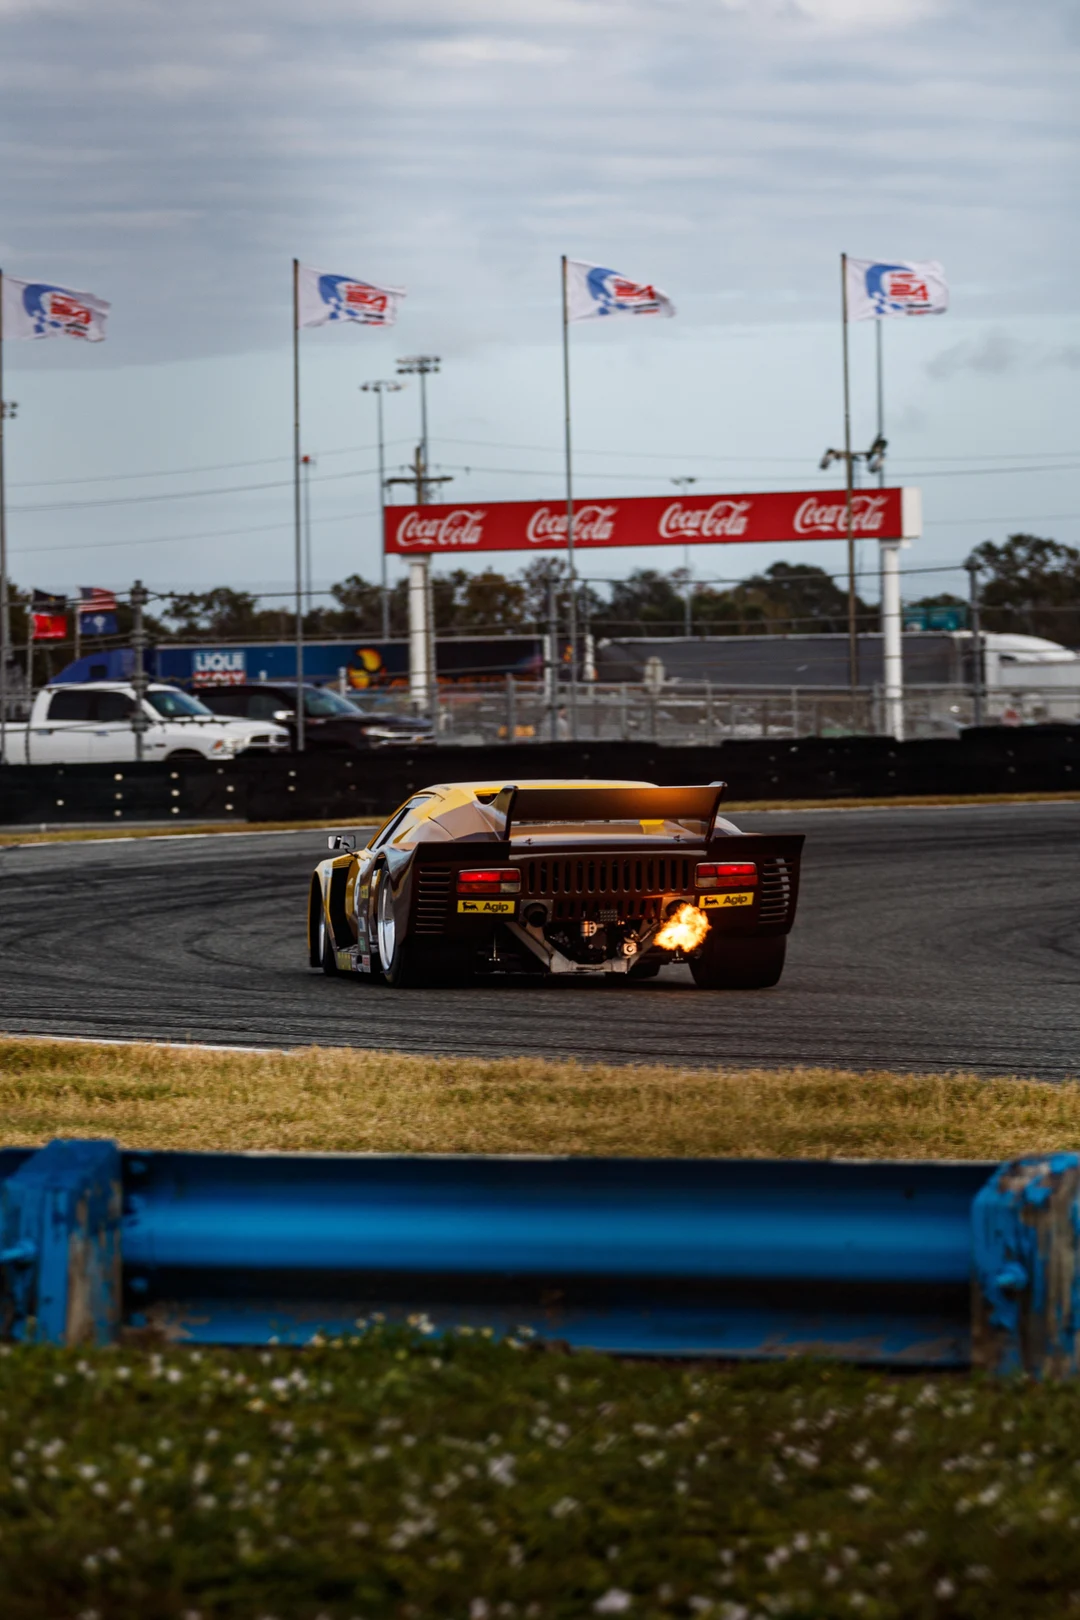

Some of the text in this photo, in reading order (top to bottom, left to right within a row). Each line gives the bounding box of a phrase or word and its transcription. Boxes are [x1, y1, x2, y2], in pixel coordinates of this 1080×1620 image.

[396, 509, 488, 547] Coca-Cola
[658, 499, 754, 539] Coca-Cola
[194, 651, 244, 671] LIQUI
[482, 900, 509, 913] Agip
[723, 894, 748, 906] Agip
